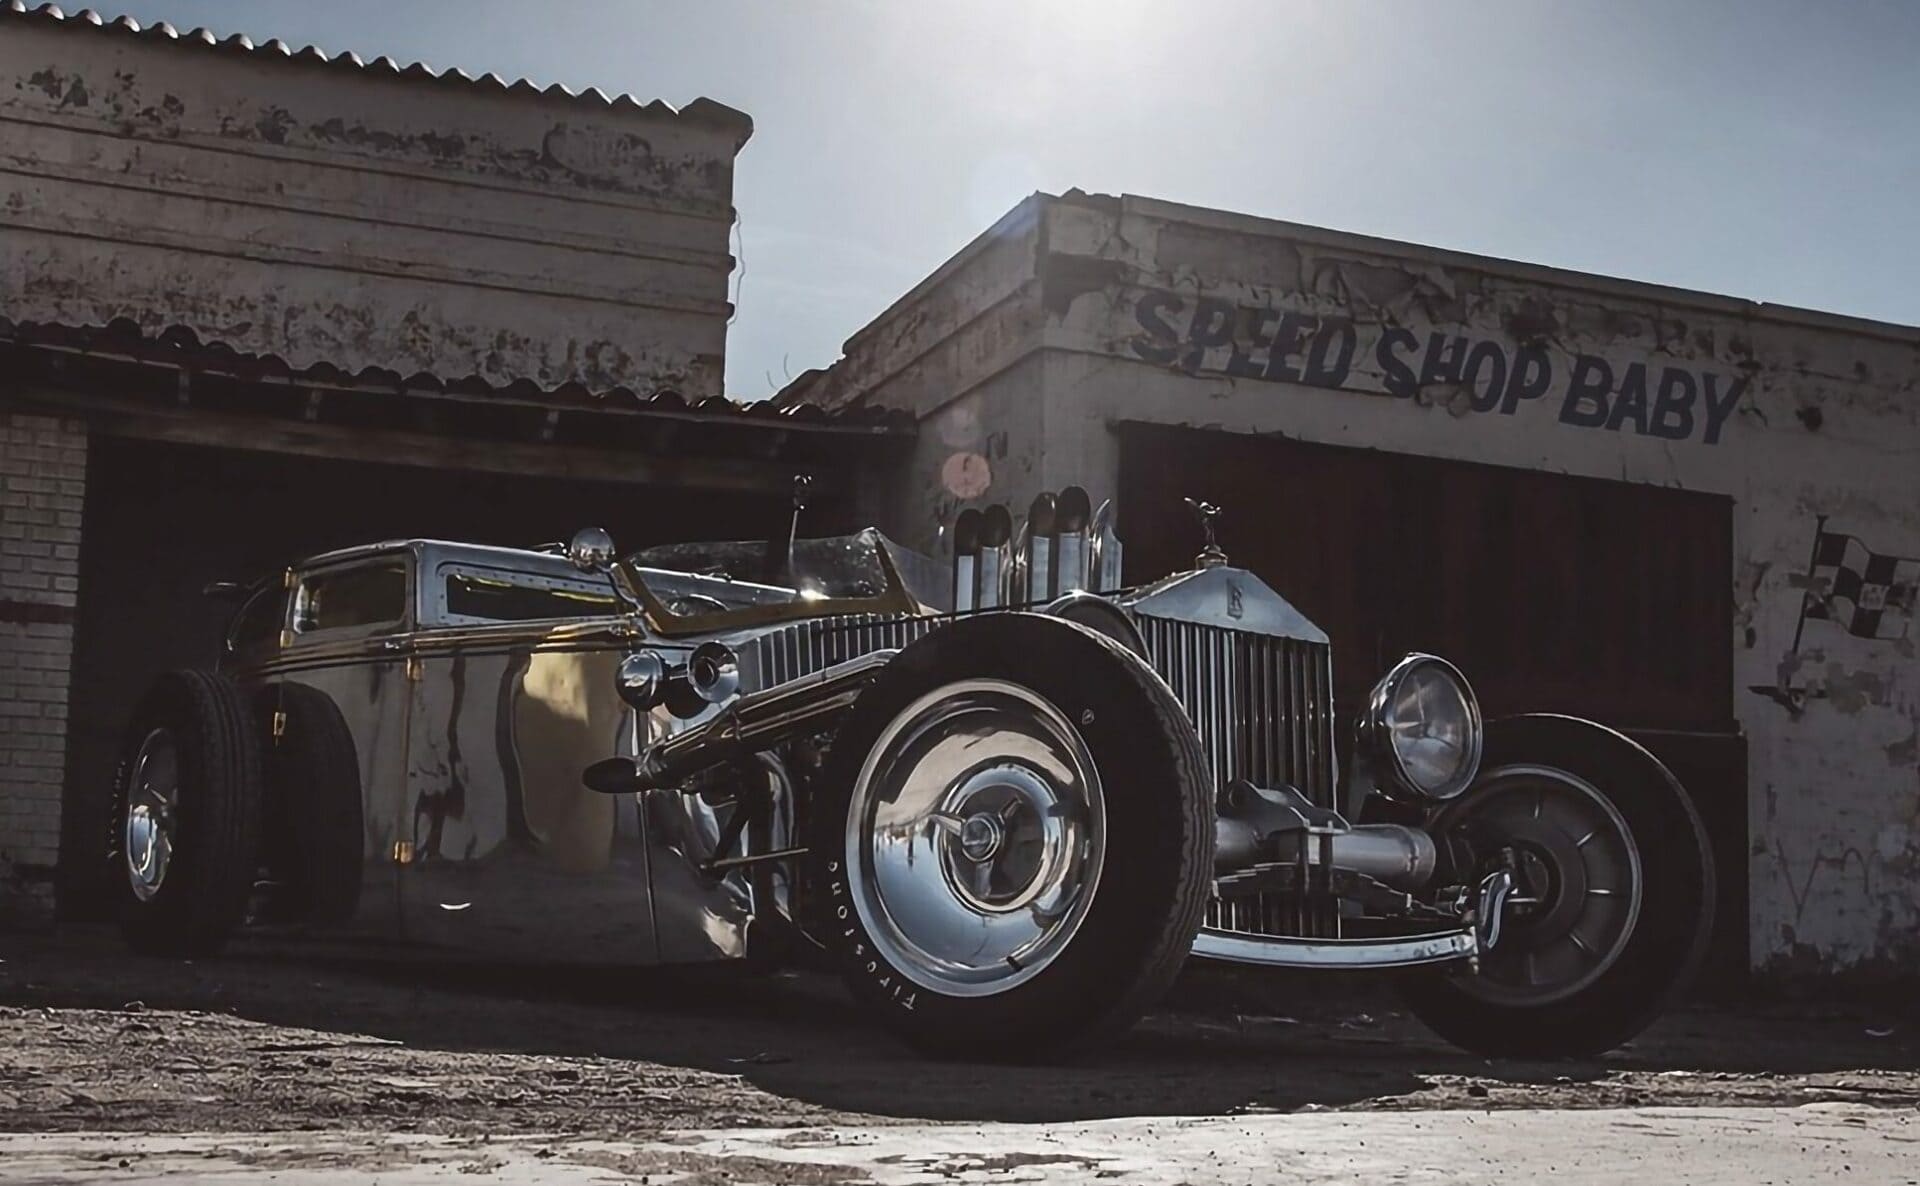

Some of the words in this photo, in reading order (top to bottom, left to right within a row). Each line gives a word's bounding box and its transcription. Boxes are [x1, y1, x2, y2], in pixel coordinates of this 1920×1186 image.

[1132, 289, 1356, 388] SPEED
[1376, 327, 1551, 415] SHOP
[1559, 355, 1747, 445] BABY
